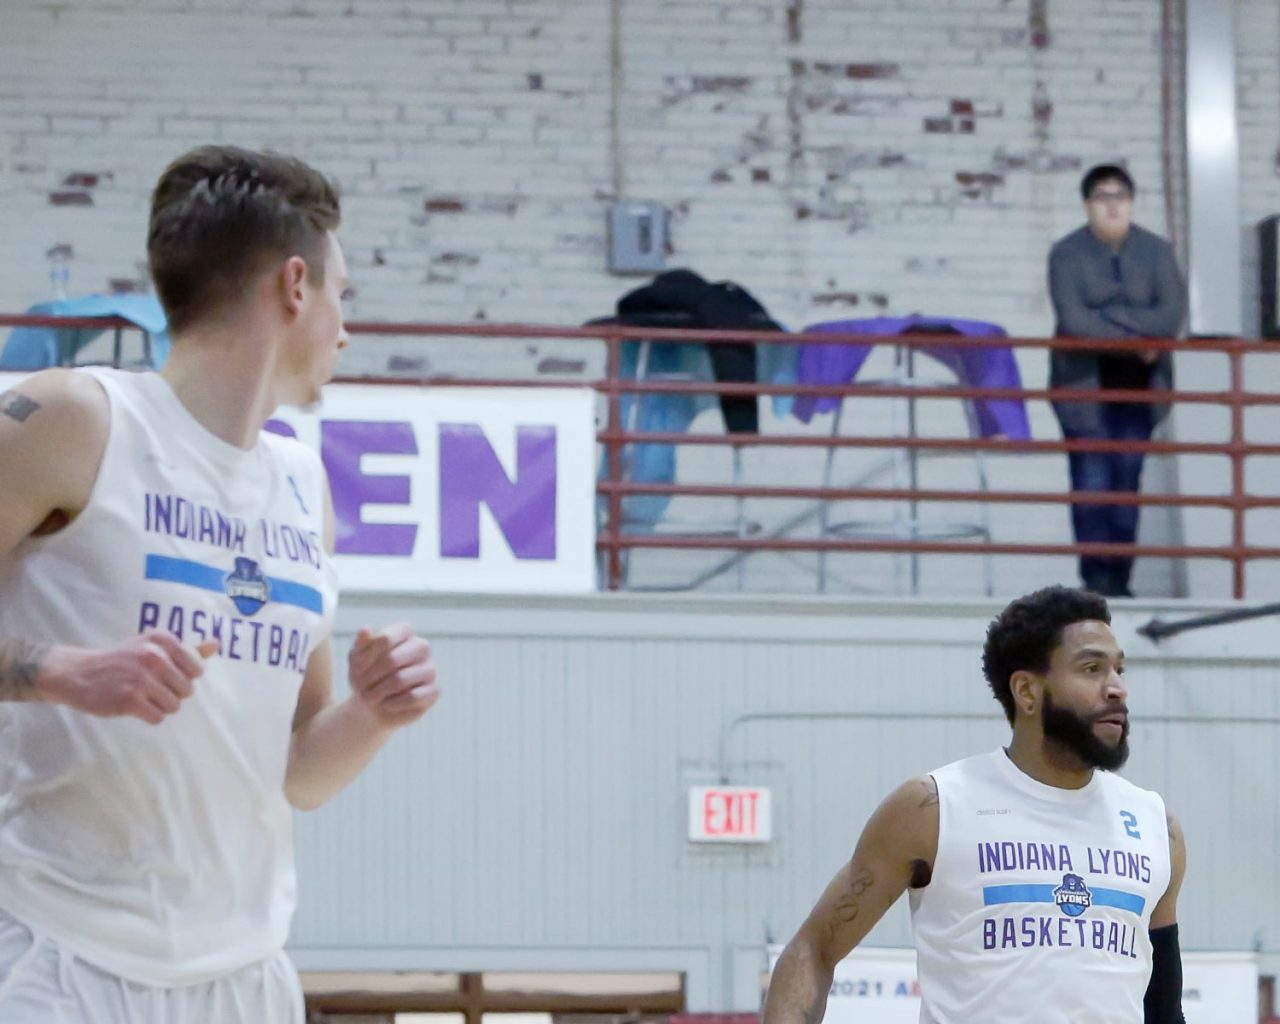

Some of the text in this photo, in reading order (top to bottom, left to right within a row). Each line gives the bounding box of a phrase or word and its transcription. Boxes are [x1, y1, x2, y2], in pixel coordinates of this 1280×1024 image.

[262, 419, 557, 560] EN
[144, 493, 247, 552] INDIANA
[138, 602, 309, 673] BASKETBAL
[703, 790, 761, 836] EXIT
[1119, 809, 1142, 840] 2
[978, 841, 1151, 884] INDIANA LYONS
[1057, 894, 1089, 906] LYONS
[983, 917, 1137, 960] BASKETBALL
[894, 979, 922, 996] AB
